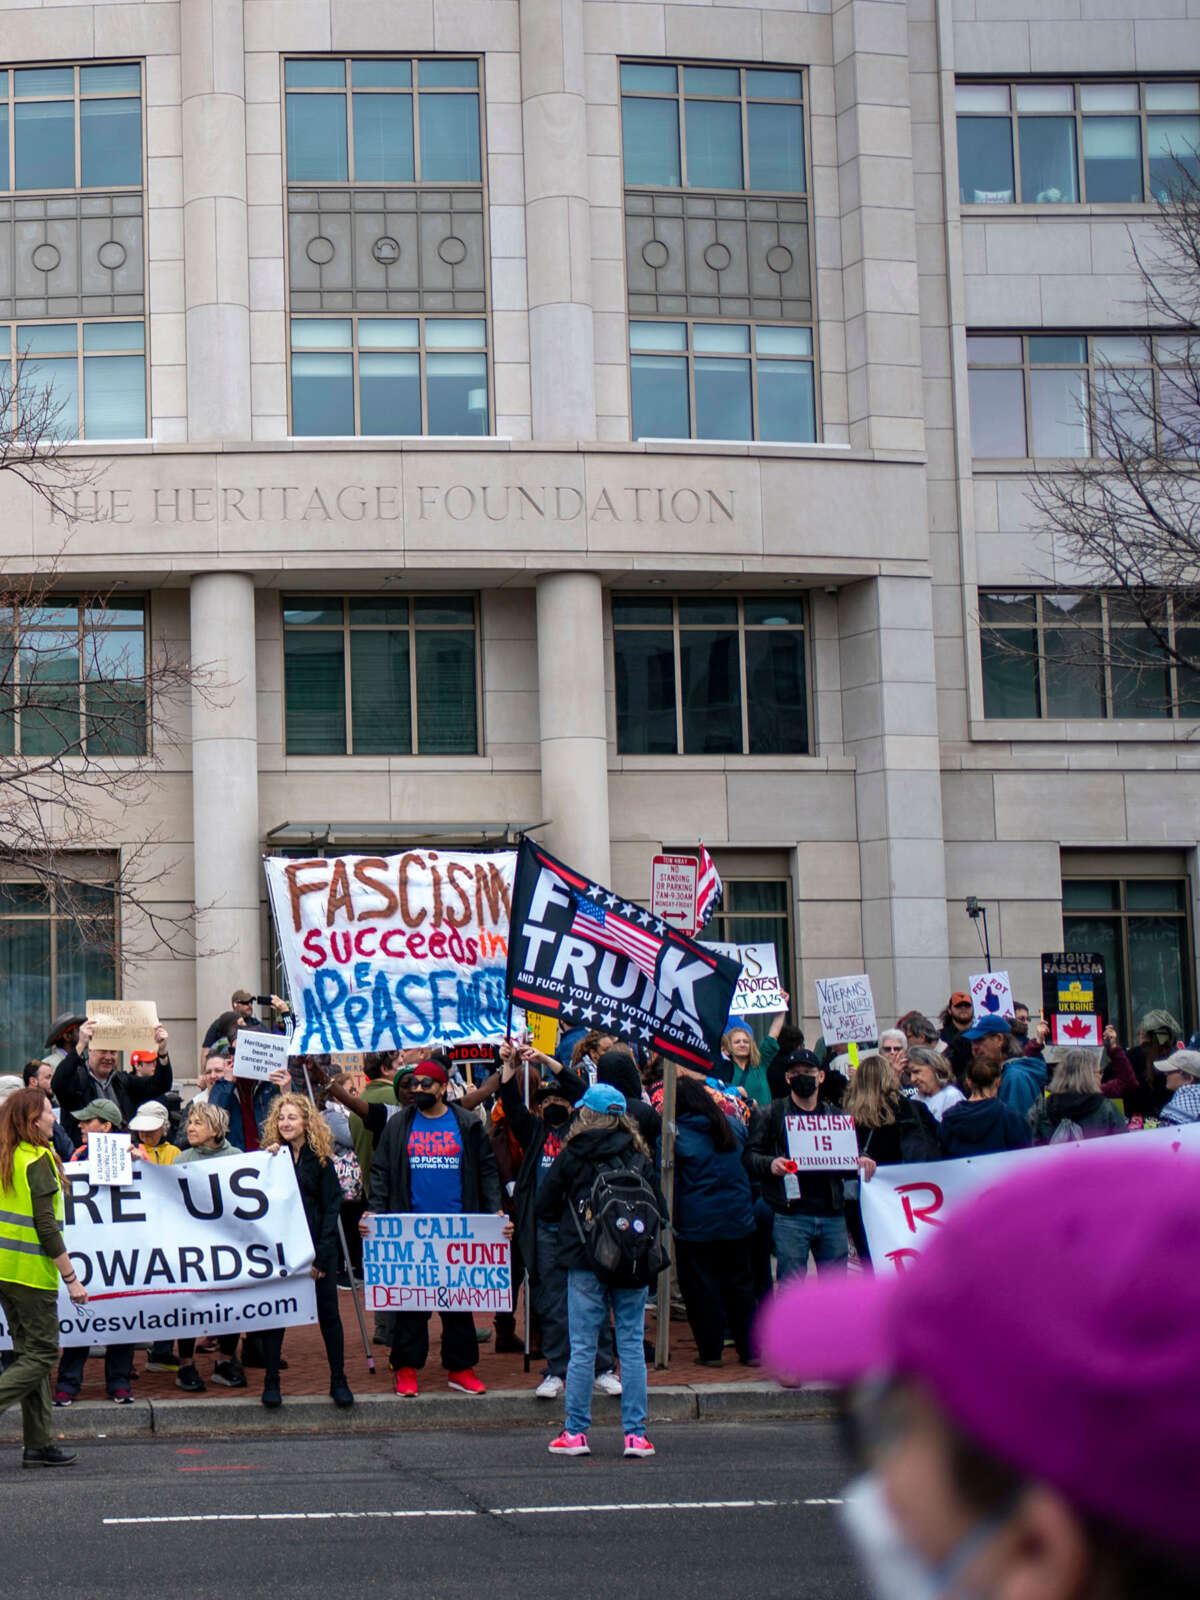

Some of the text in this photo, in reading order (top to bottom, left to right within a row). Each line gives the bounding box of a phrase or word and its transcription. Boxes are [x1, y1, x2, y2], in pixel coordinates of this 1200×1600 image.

[151, 484, 400, 524] HERITAGE
[417, 484, 737, 525] FOUNDATION
[670, 865, 680, 873] NO
[660, 873, 690, 883] STANDING
[656, 882, 693, 892] OR PARKING
[1053, 953, 1093, 963] FIGHT
[1044, 963, 1103, 974] FASCISM
[517, 972, 534, 985] AND
[536, 977, 565, 994] FUCK
[569, 986, 593, 1002] YOU
[594, 994, 618, 1010] FOR
[621, 1002, 661, 1030] VOTING
[662, 1023, 684, 1042] FOR
[1058, 1001, 1095, 1012] UKRAINE
[243, 1039, 285, 1052] Heritage has
[251, 1048, 268, 1057] been
[240, 1055, 282, 1068] cancer since
[785, 1114, 856, 1132] FASCISM
[409, 1130, 455, 1144] FUCK
[814, 1135, 833, 1151] IS
[407, 1143, 461, 1157] TRUMP
[421, 1156, 443, 1164] FUCK
[178, 1167, 270, 1221] US
[413, 1216, 474, 1239] CALL
[364, 1240, 509, 1265] HIM A CUNT
[365, 1263, 510, 1290] BUT HE LACKS
